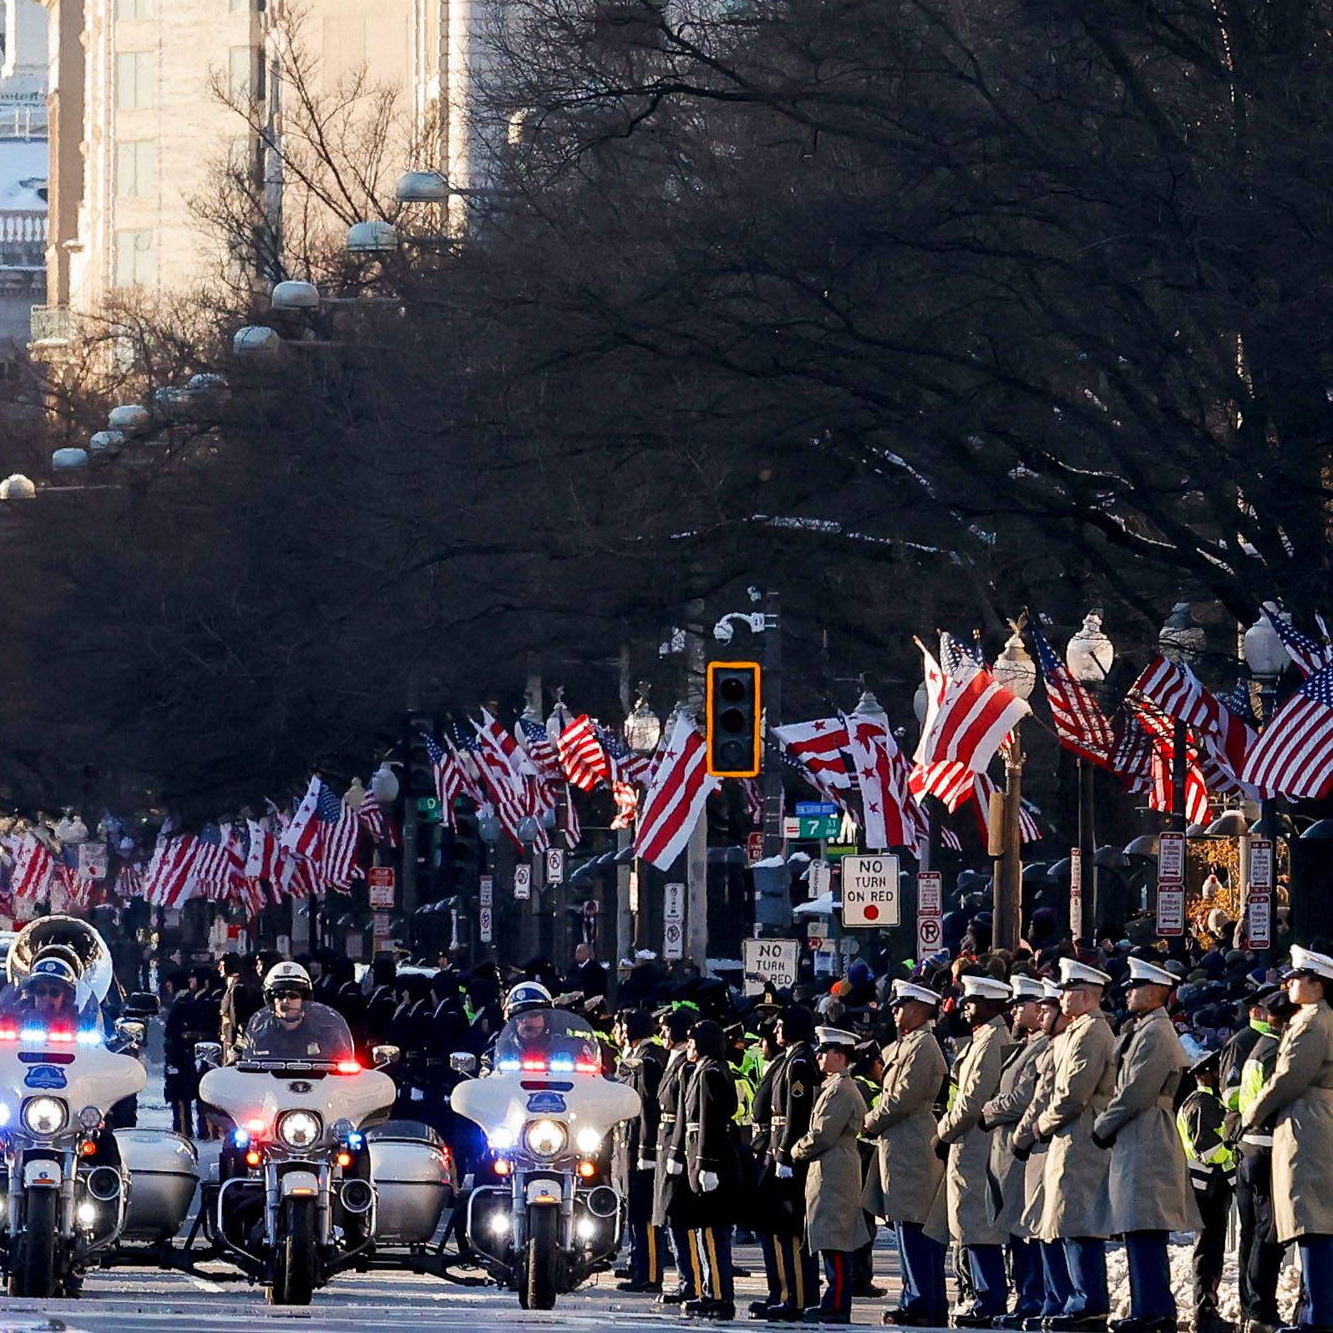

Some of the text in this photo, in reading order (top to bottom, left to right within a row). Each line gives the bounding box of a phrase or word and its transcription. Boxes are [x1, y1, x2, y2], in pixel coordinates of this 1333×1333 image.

[808, 819, 820, 835] 7
[860, 860, 883, 873] NO
[855, 877, 886, 887] TURN
[847, 891, 893, 902] ON RED
[759, 945, 782, 957] NO
[756, 960, 785, 971] TURN
[770, 974, 792, 984] RED
